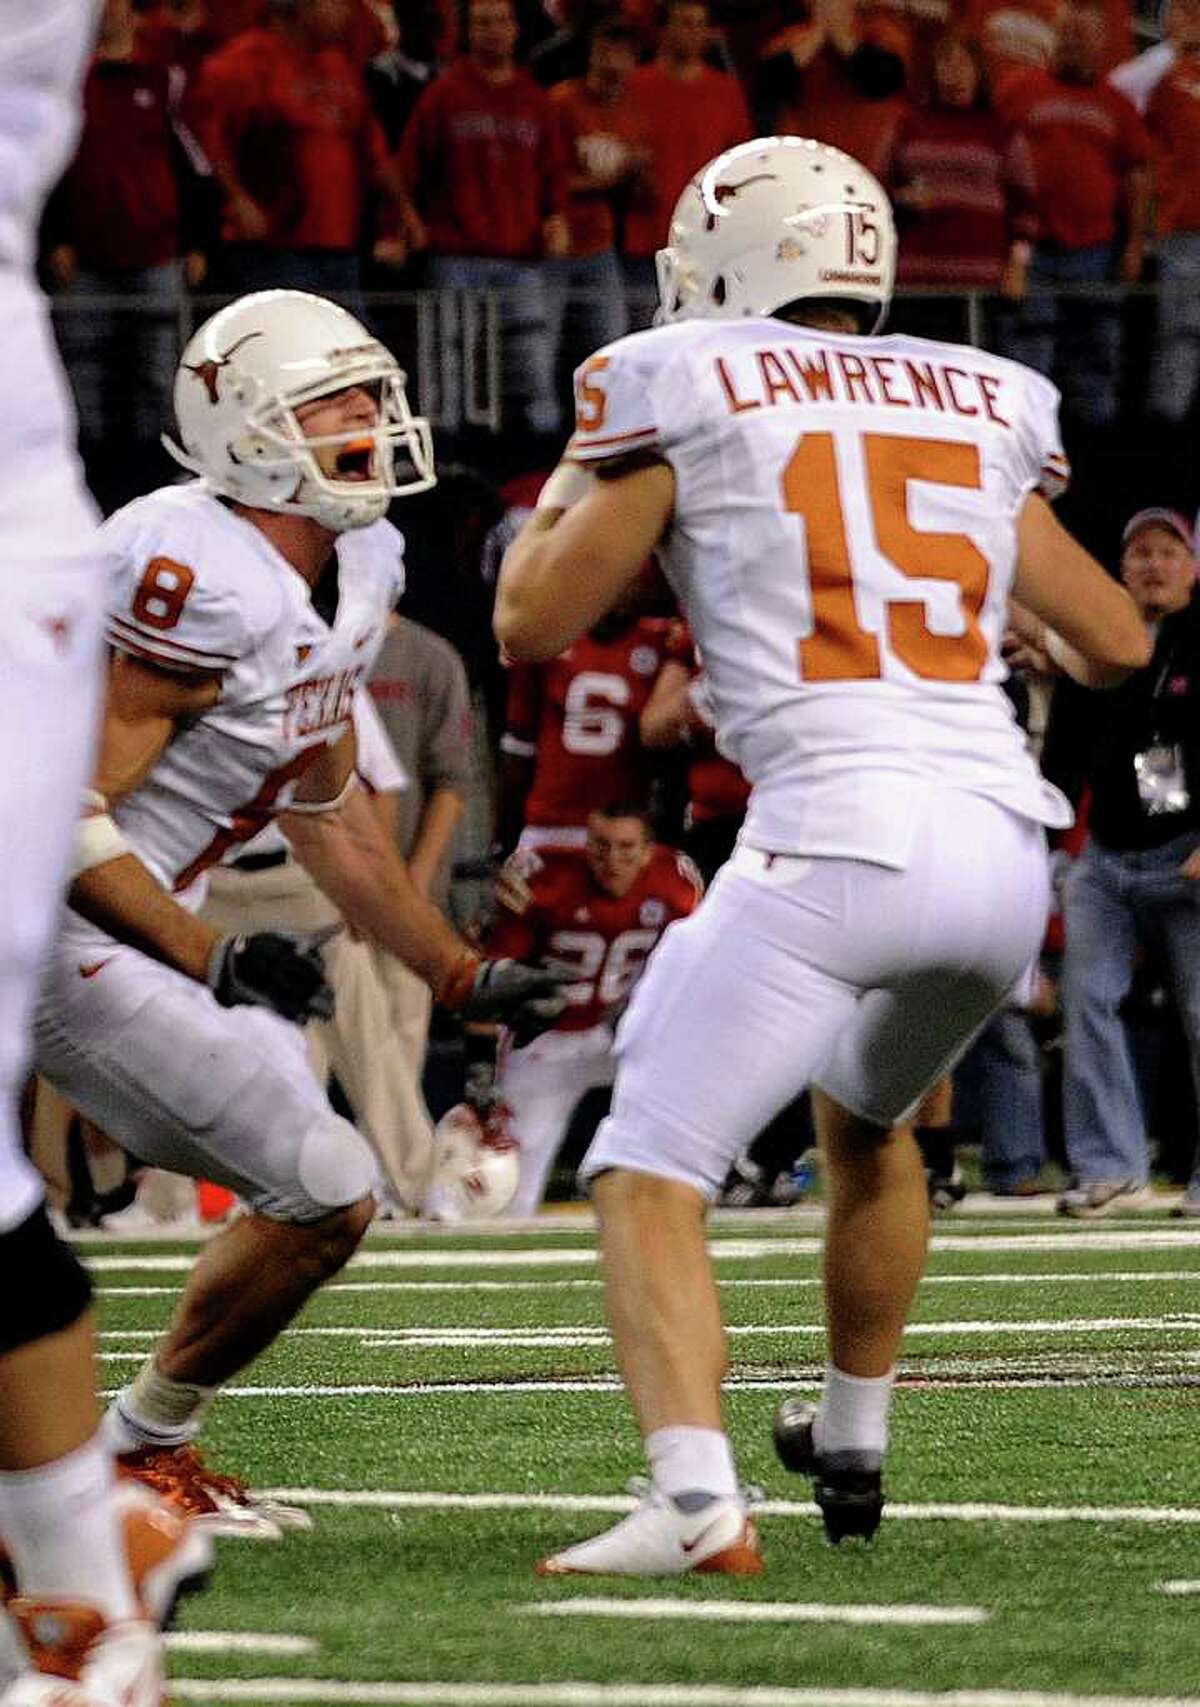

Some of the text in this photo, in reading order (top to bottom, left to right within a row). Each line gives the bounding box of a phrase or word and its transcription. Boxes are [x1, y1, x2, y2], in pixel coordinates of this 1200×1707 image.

[844, 201, 880, 265] 15
[714, 349, 1010, 428] LAWRENCE
[132, 555, 195, 630] 8
[780, 431, 990, 682] 15
[562, 671, 630, 756] 6
